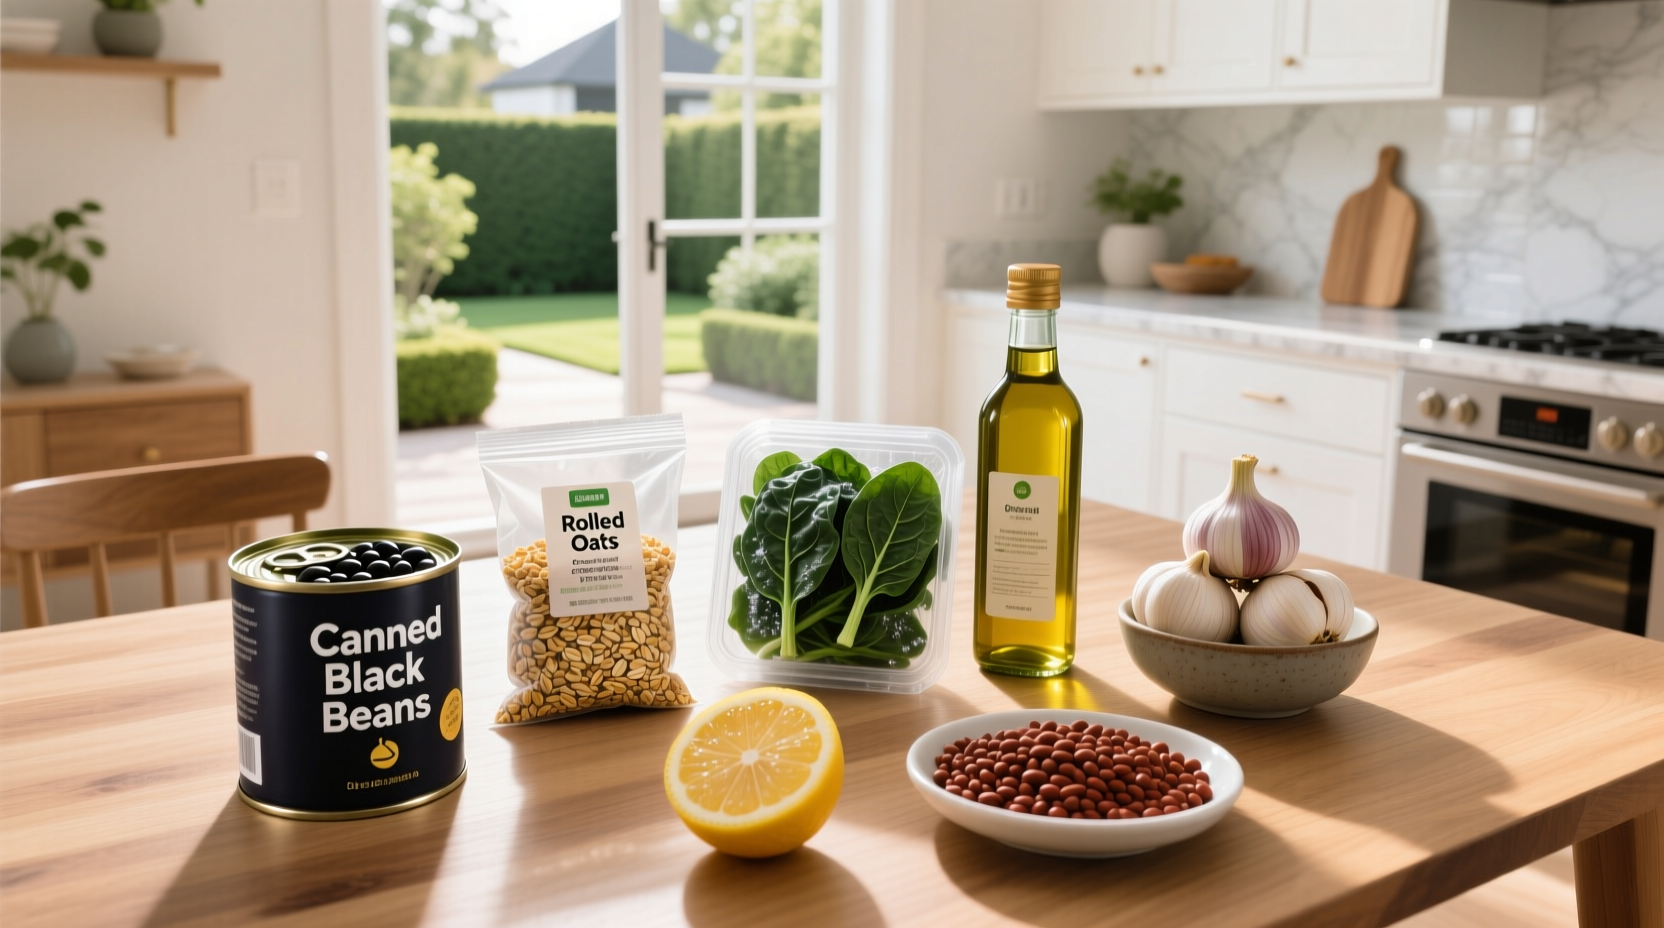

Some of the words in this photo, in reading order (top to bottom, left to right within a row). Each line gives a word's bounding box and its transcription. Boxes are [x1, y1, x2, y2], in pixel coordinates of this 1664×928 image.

[562, 511, 624, 532] Rolled
[571, 533, 619, 551] Oats
[310, 605, 442, 657] Canned
[325, 651, 425, 695] Black
[323, 693, 431, 733] Beans
